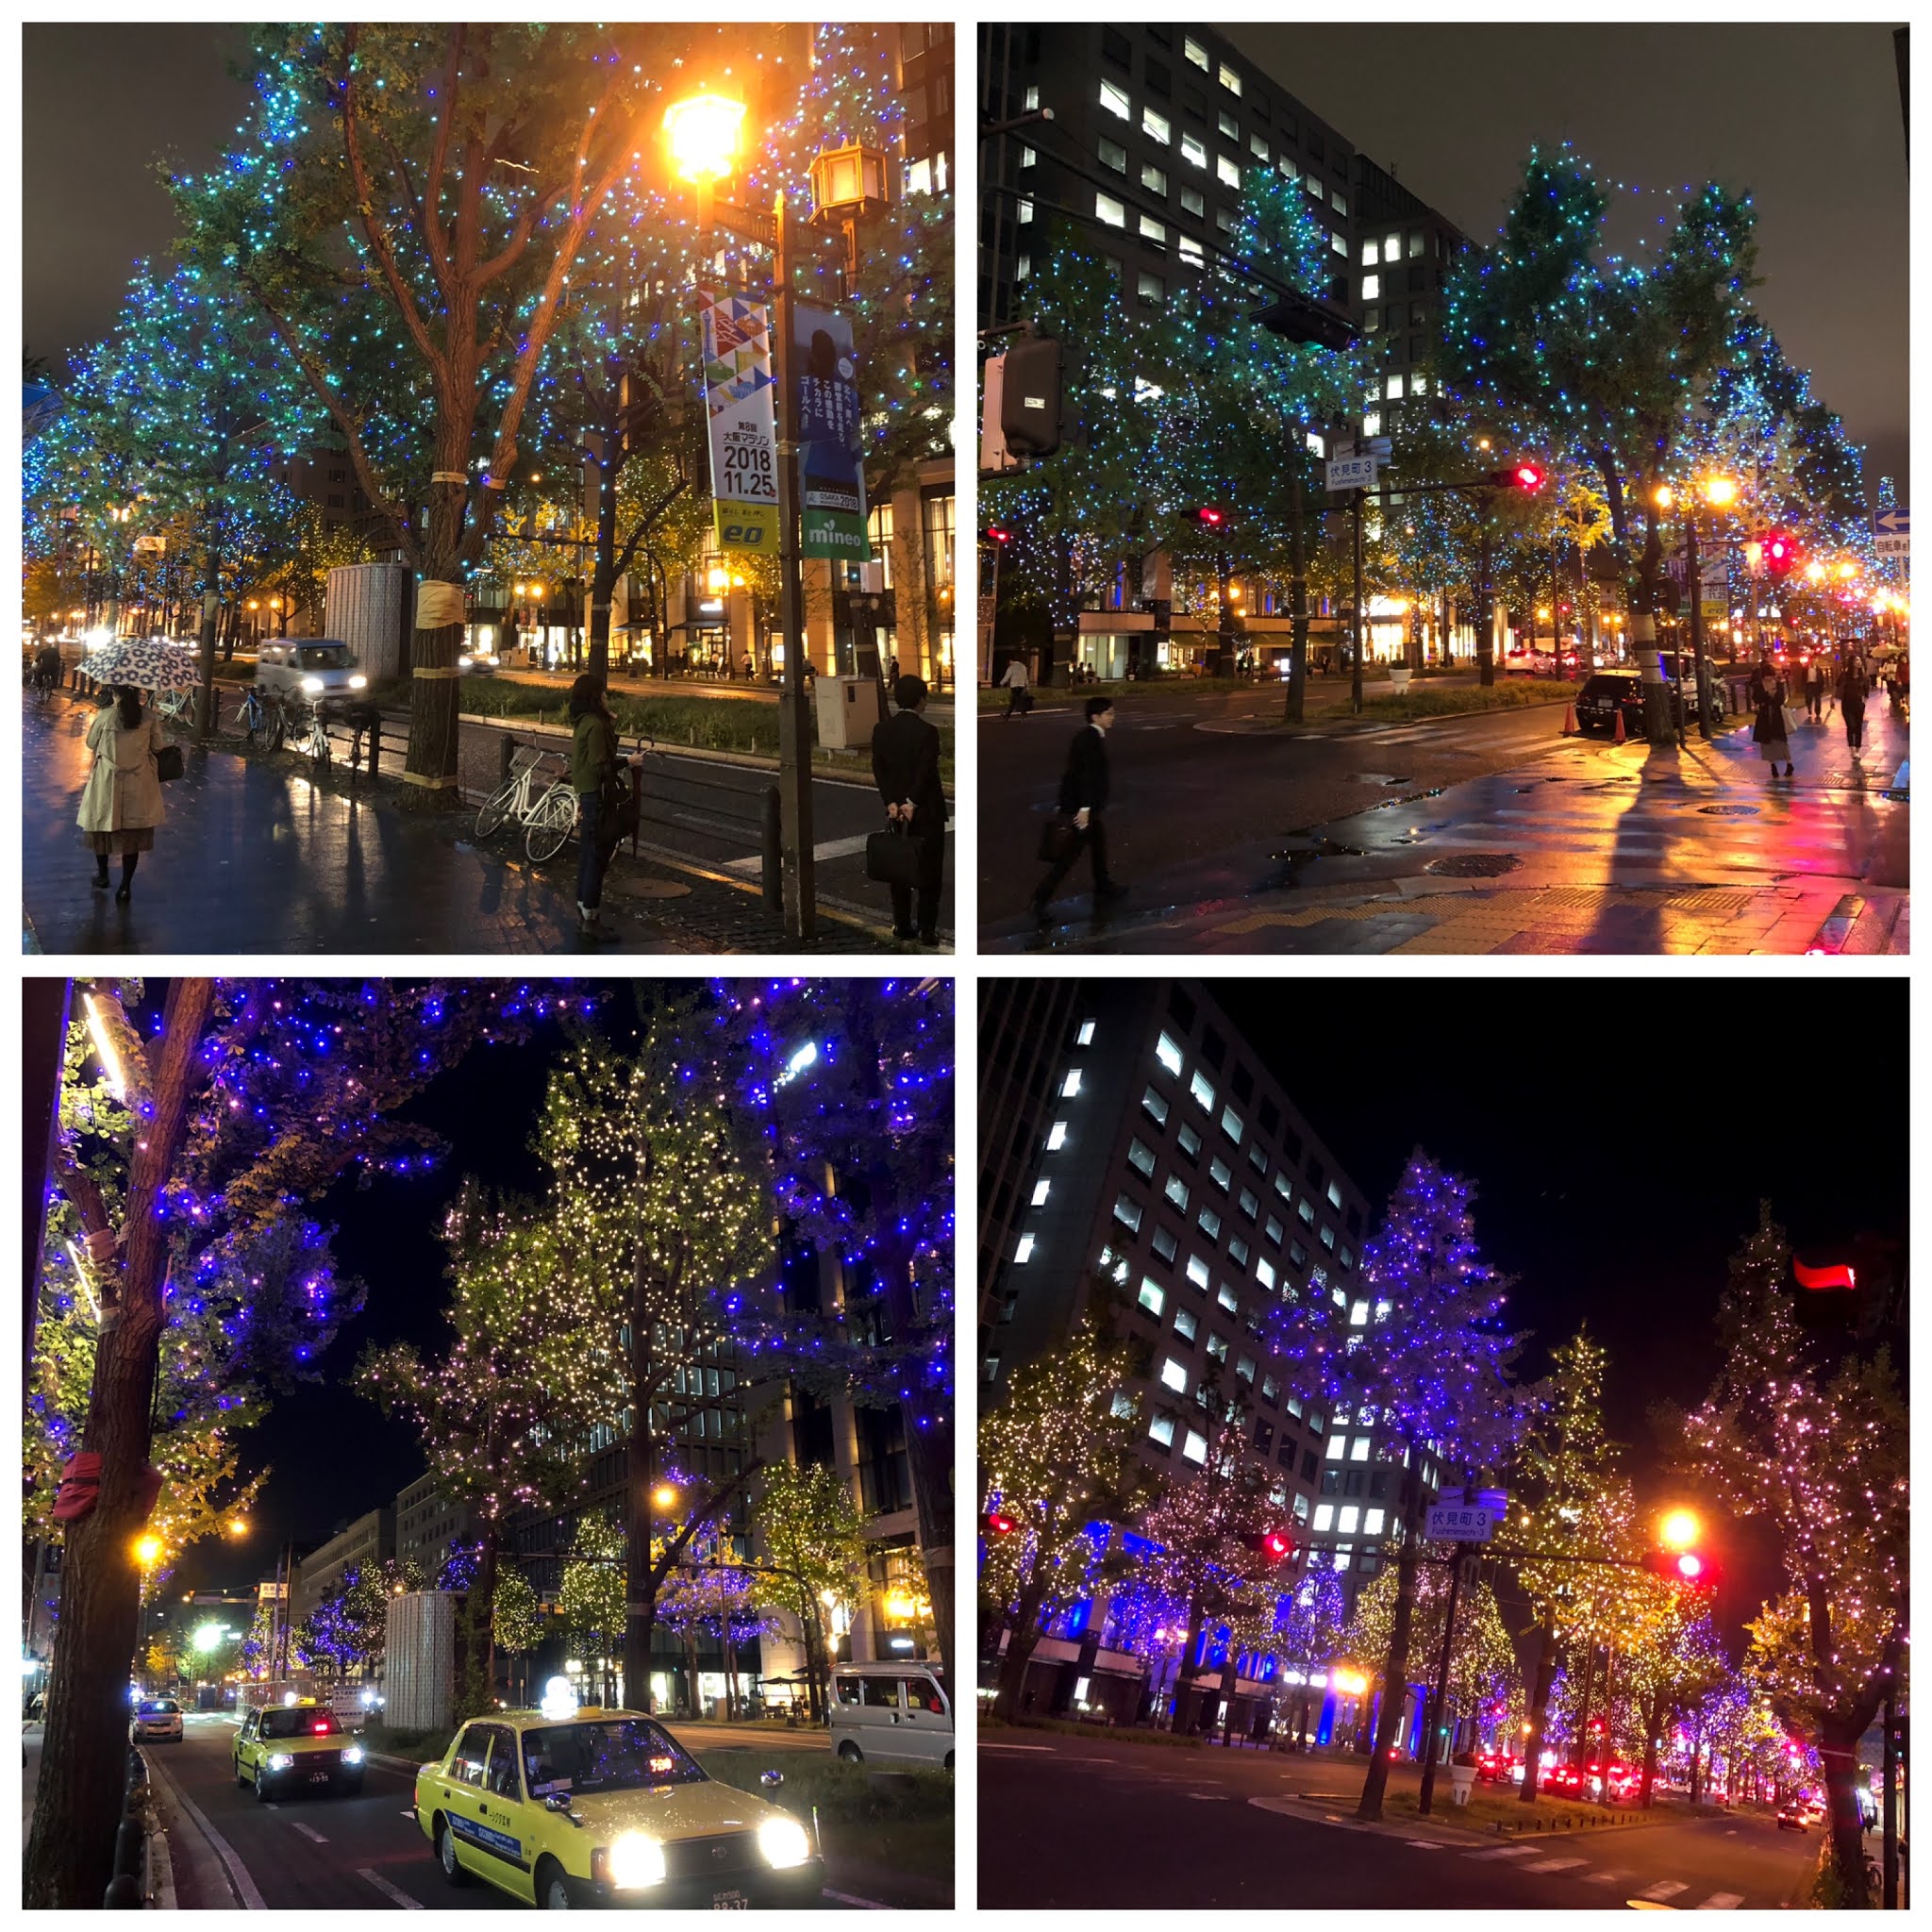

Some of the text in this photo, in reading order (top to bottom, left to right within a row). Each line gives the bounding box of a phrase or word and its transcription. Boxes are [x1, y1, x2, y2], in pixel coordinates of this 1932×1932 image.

[723, 432, 770, 446] 大阪マラソン
[724, 445, 771, 472] 2018
[1330, 460, 1372, 478] 伏見町 3
[724, 471, 774, 496] 11.25
[820, 492, 858, 509] OSAKA 2018
[724, 525, 763, 546] eo
[809, 519, 860, 547] mineo
[1432, 1511, 1487, 1526] 伏見町 3
